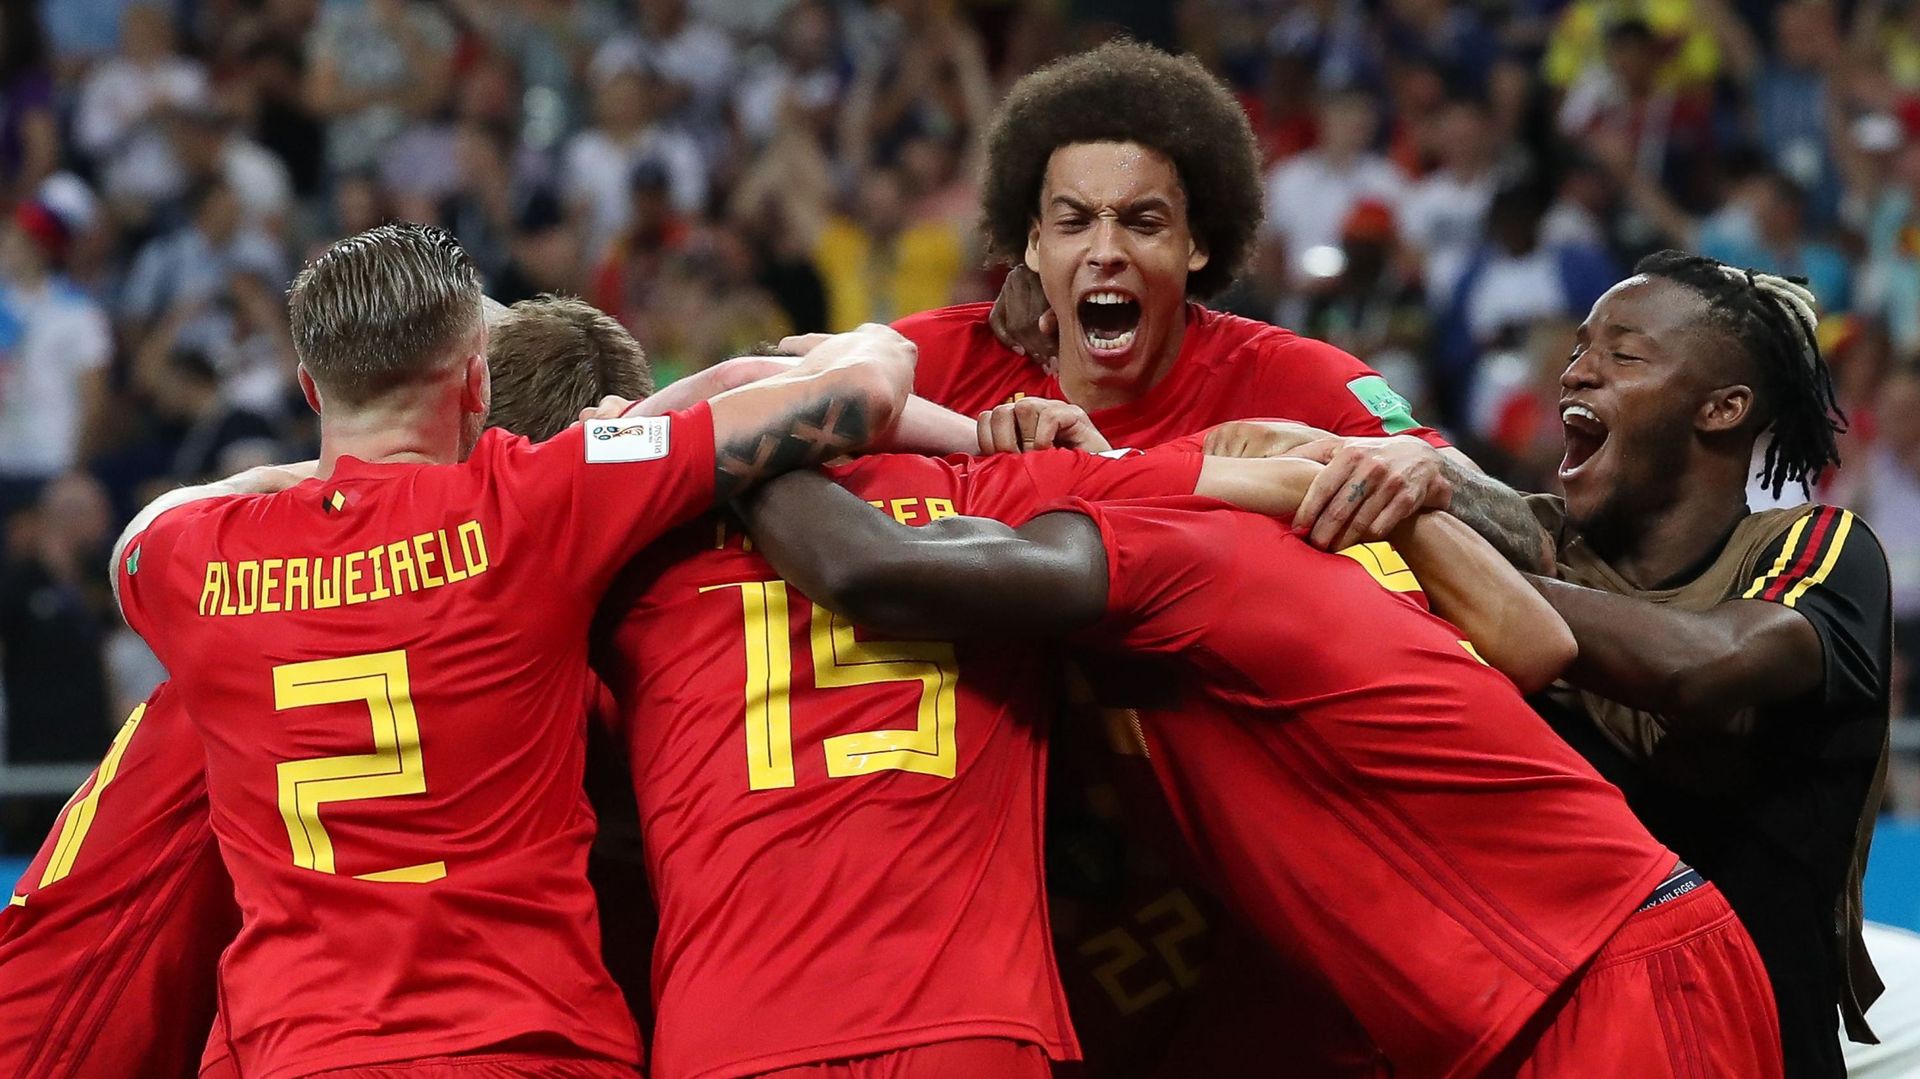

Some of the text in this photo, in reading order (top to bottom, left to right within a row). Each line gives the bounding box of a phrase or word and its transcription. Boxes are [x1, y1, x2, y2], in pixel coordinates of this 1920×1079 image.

[654, 424, 663, 454] RUSSIA
[199, 520, 489, 616] ALDERWEIRELD
[699, 579, 958, 790] 15
[272, 649, 447, 883] 2
[1658, 880, 1697, 904] HILFIGER
[1078, 888, 1208, 1016] 22
